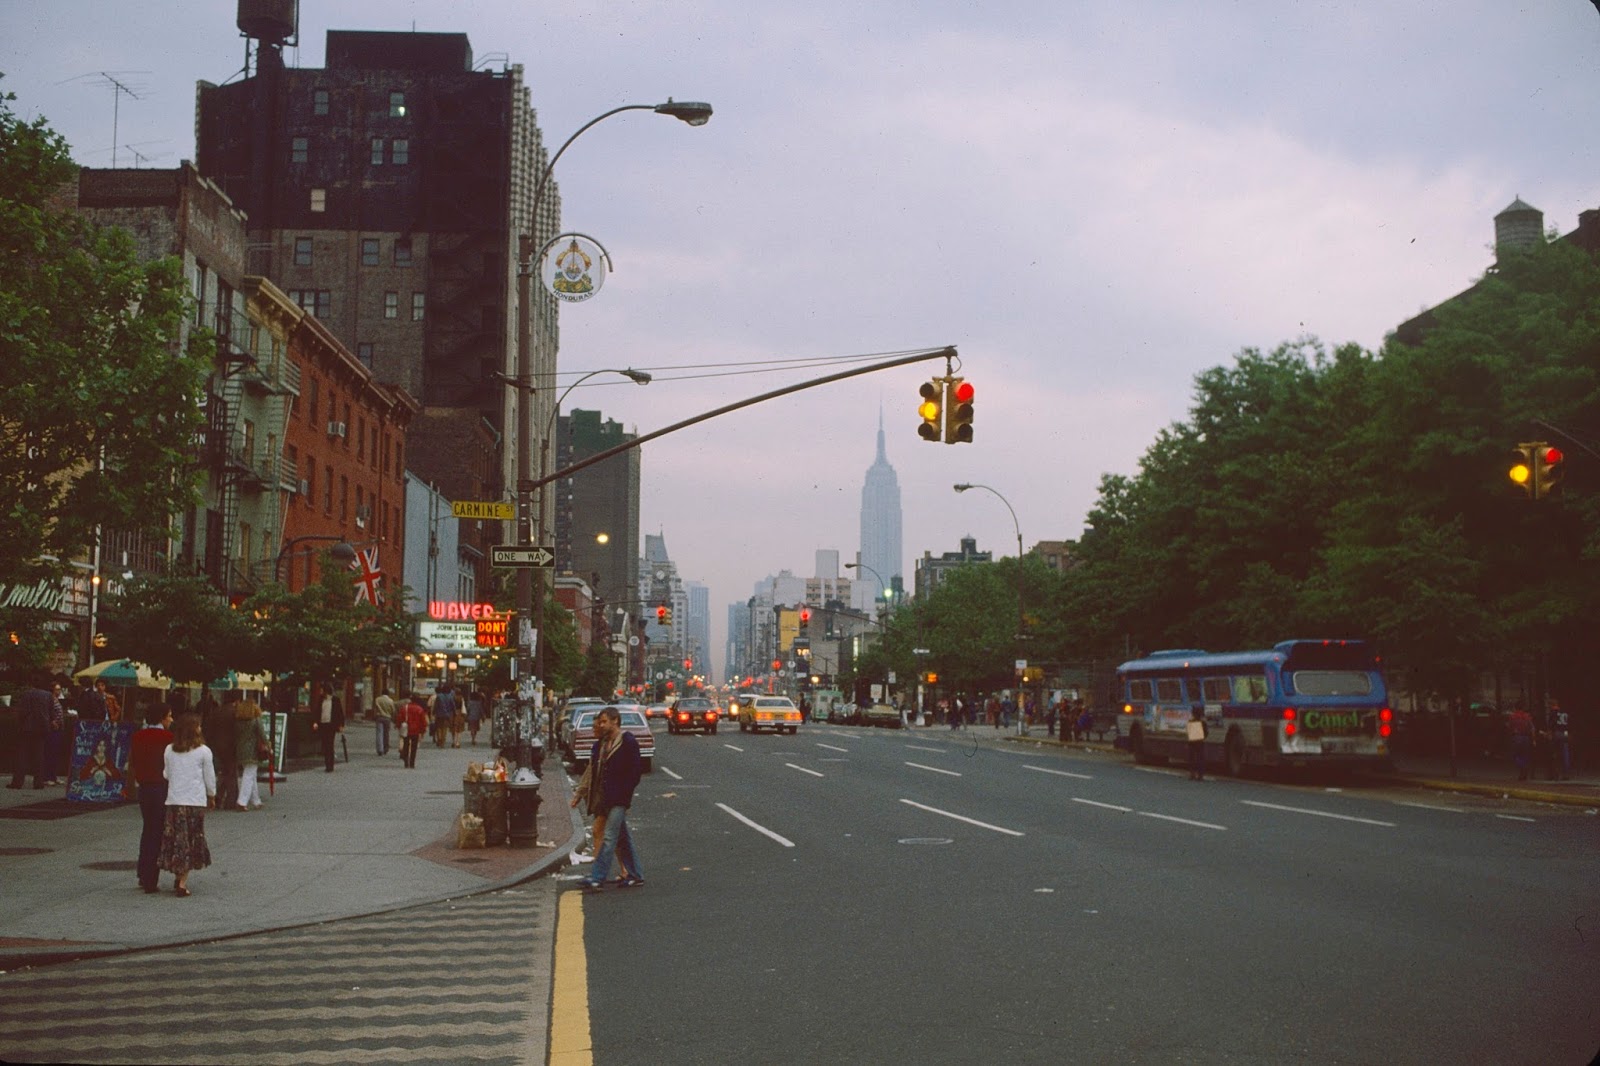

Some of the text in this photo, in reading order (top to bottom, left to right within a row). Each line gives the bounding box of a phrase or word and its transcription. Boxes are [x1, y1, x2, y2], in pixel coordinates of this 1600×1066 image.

[553, 288, 593, 301] HONDURAS
[454, 502, 514, 517] CARMINE ST
[497, 552, 546, 561] ONE WAY
[430, 601, 511, 620] WAVER
[454, 624, 475, 632] SAVAGE
[478, 621, 507, 633] DONT
[478, 634, 507, 646] WALK
